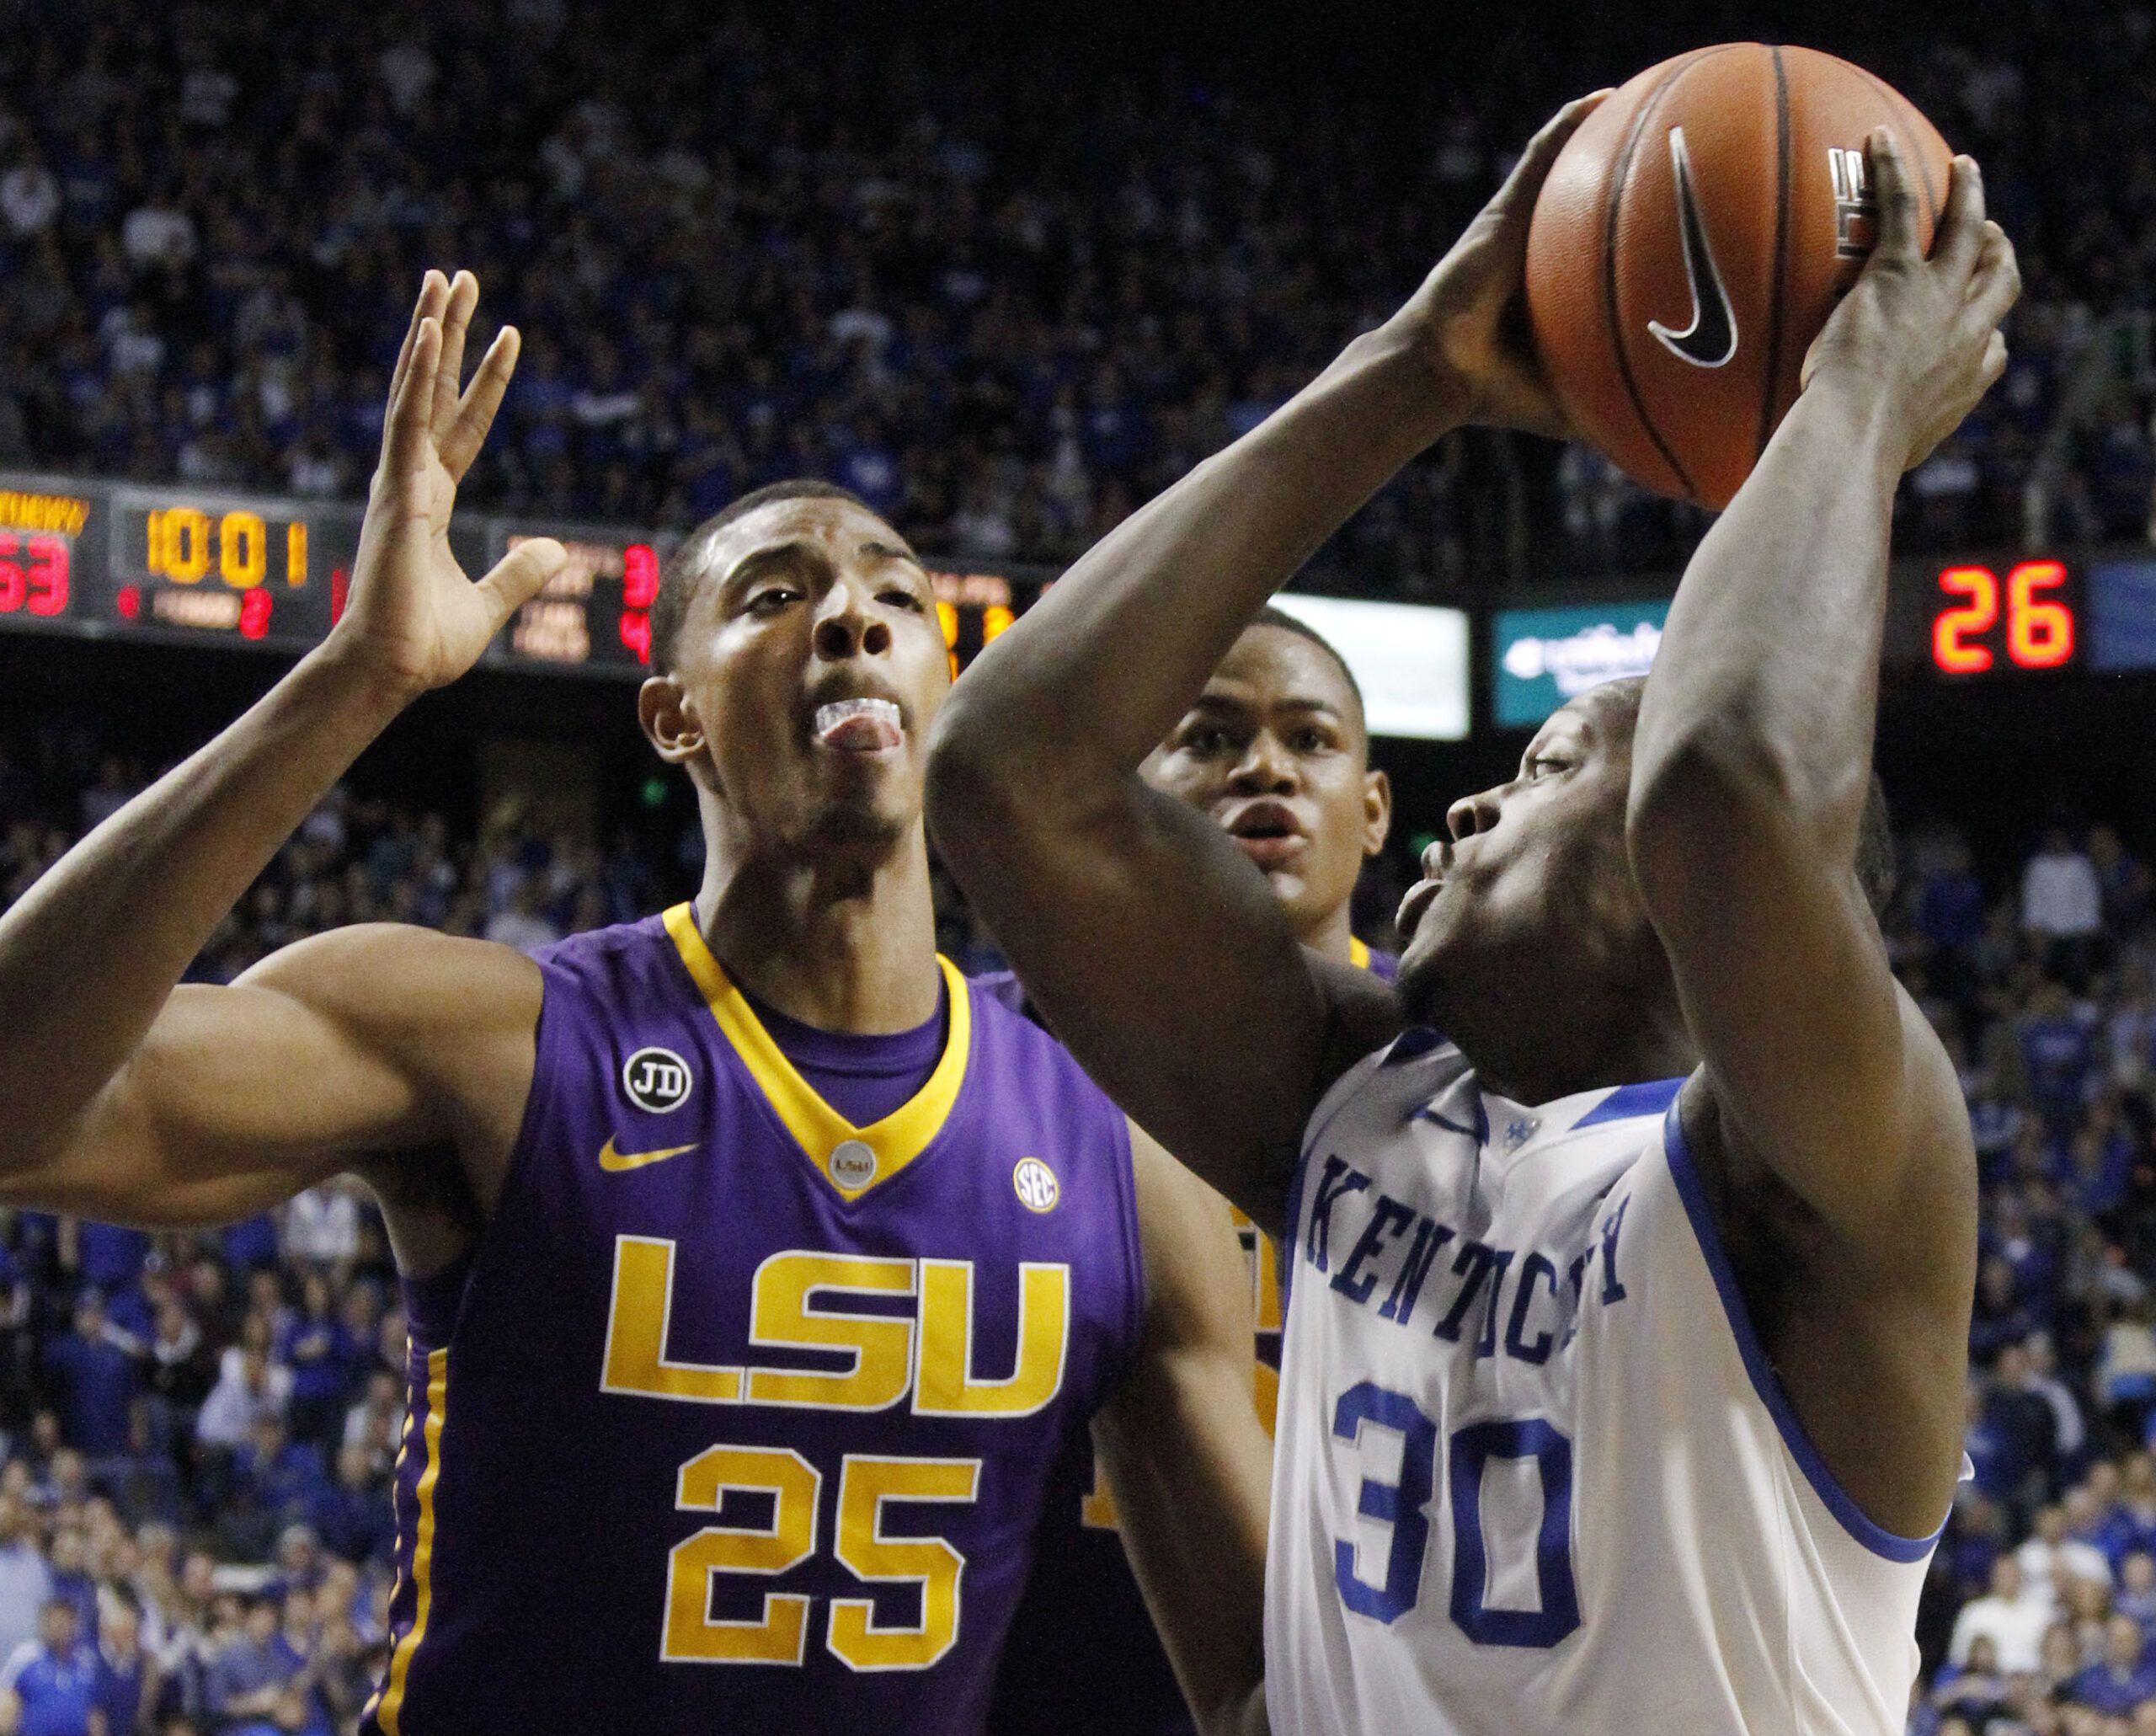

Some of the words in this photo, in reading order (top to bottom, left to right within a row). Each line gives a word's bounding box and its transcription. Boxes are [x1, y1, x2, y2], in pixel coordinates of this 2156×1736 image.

[1933, 559, 2074, 674] 26
[633, 1061, 682, 1098] JD
[1017, 1162, 1054, 1208] SEC
[599, 1233, 1070, 1418] LSU
[659, 1443, 983, 1672] 25
[1332, 1381, 1582, 1648] 30
